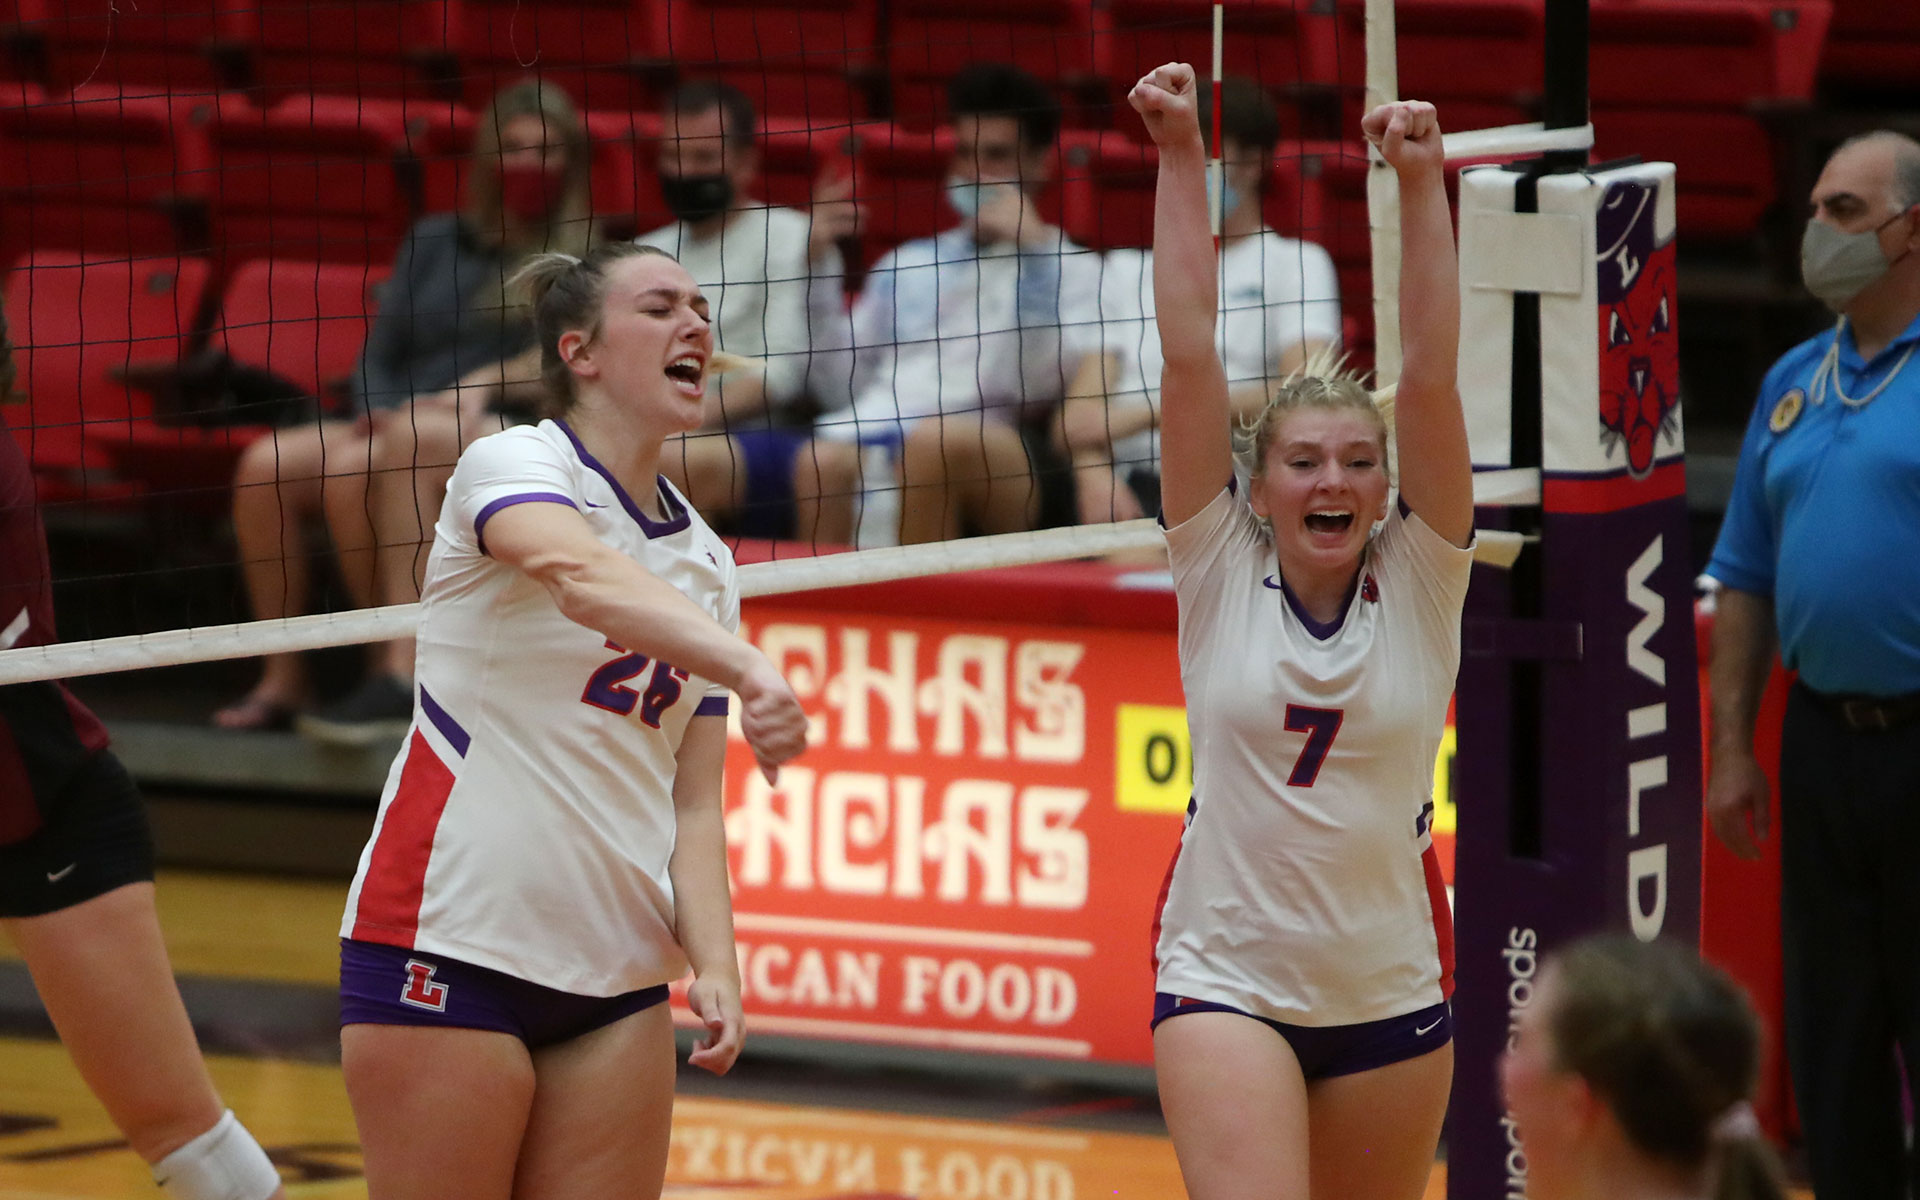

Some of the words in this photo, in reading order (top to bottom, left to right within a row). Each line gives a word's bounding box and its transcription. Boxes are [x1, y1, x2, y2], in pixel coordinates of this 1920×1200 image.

[1616, 244, 1640, 289] L
[581, 638, 691, 730] 26
[727, 621, 1087, 763] CHAS
[1284, 703, 1344, 788] 7
[1626, 533, 1668, 943] WILD
[722, 765, 1091, 910] ACIAS
[400, 958, 449, 1012] L
[903, 955, 1078, 1026] FOOD
